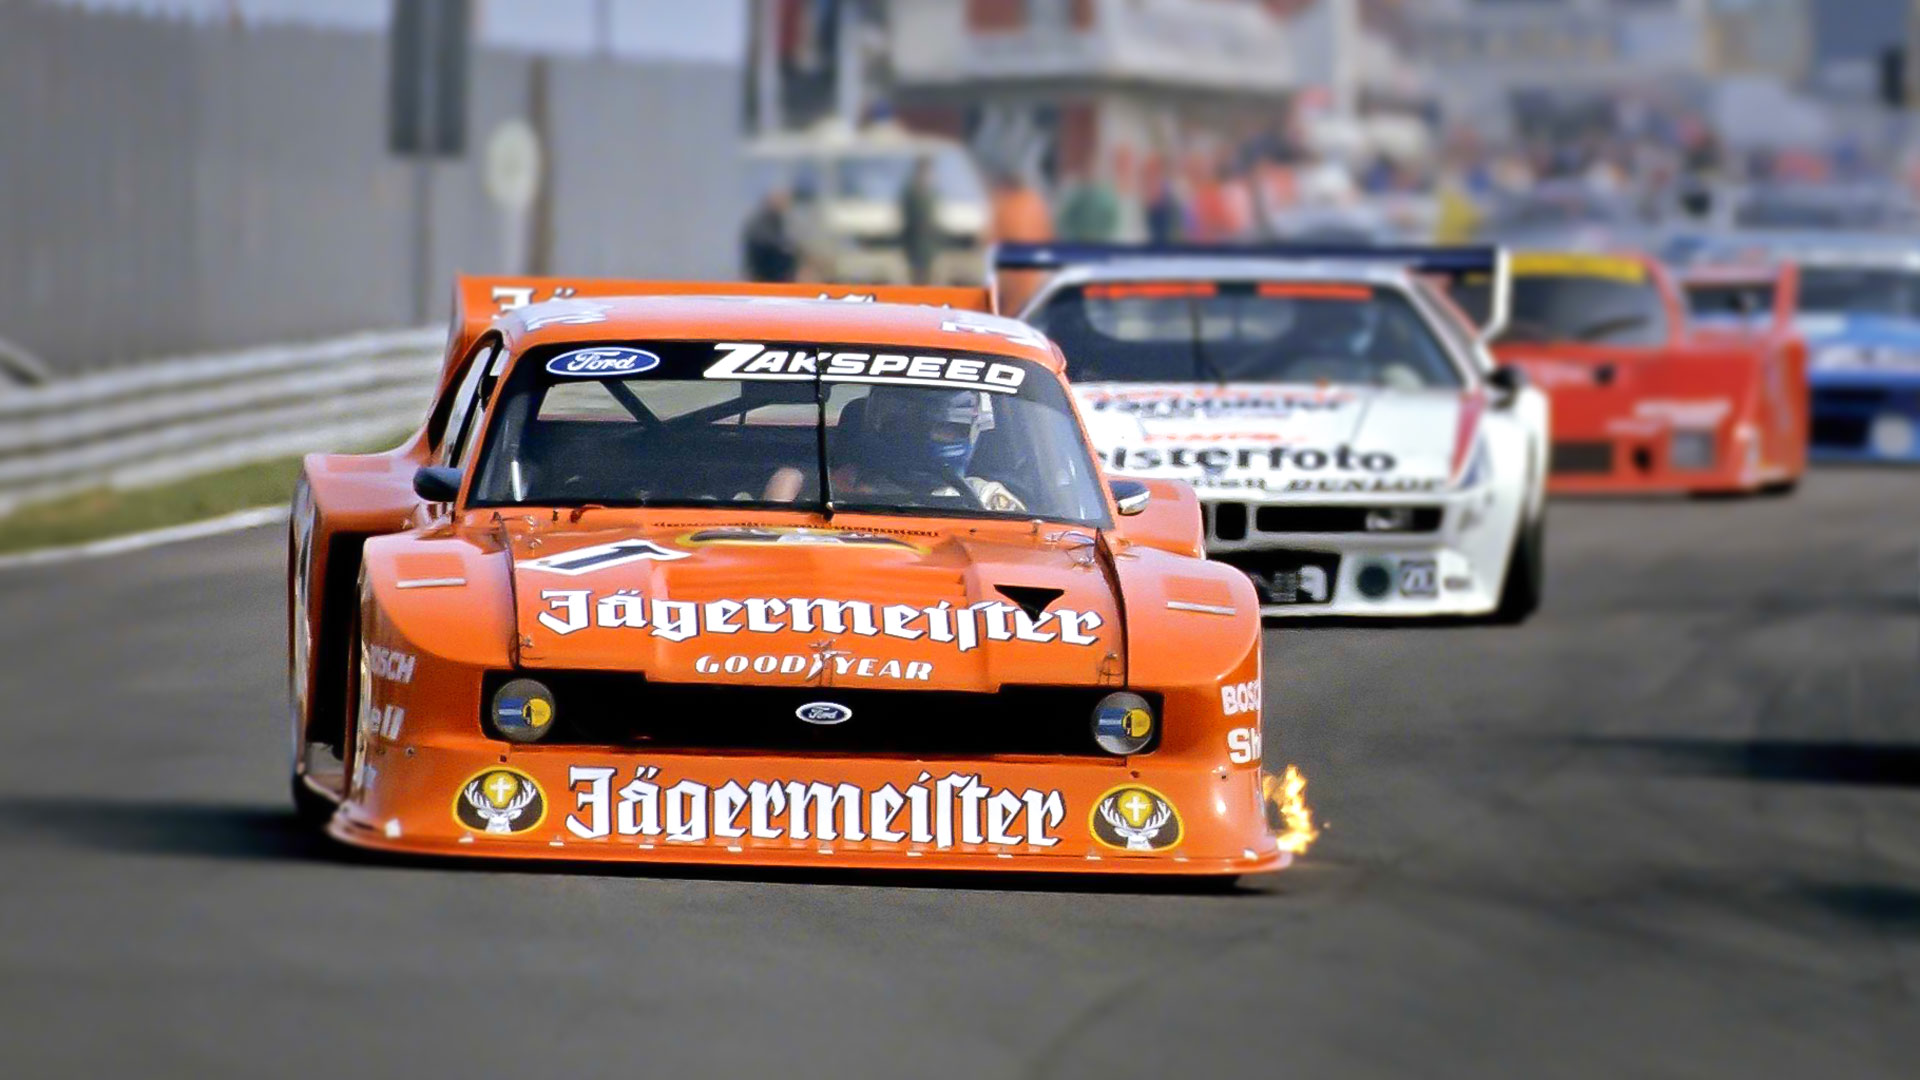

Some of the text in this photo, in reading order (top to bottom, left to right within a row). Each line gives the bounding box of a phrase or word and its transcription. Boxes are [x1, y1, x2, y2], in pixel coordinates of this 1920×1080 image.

[566, 350, 638, 372] Ford
[703, 342, 1026, 389] ZAKSPEED
[537, 586, 1104, 651] Jägermeister
[694, 652, 934, 682] GOODYEAR
[565, 764, 1067, 850] Jägermeister
